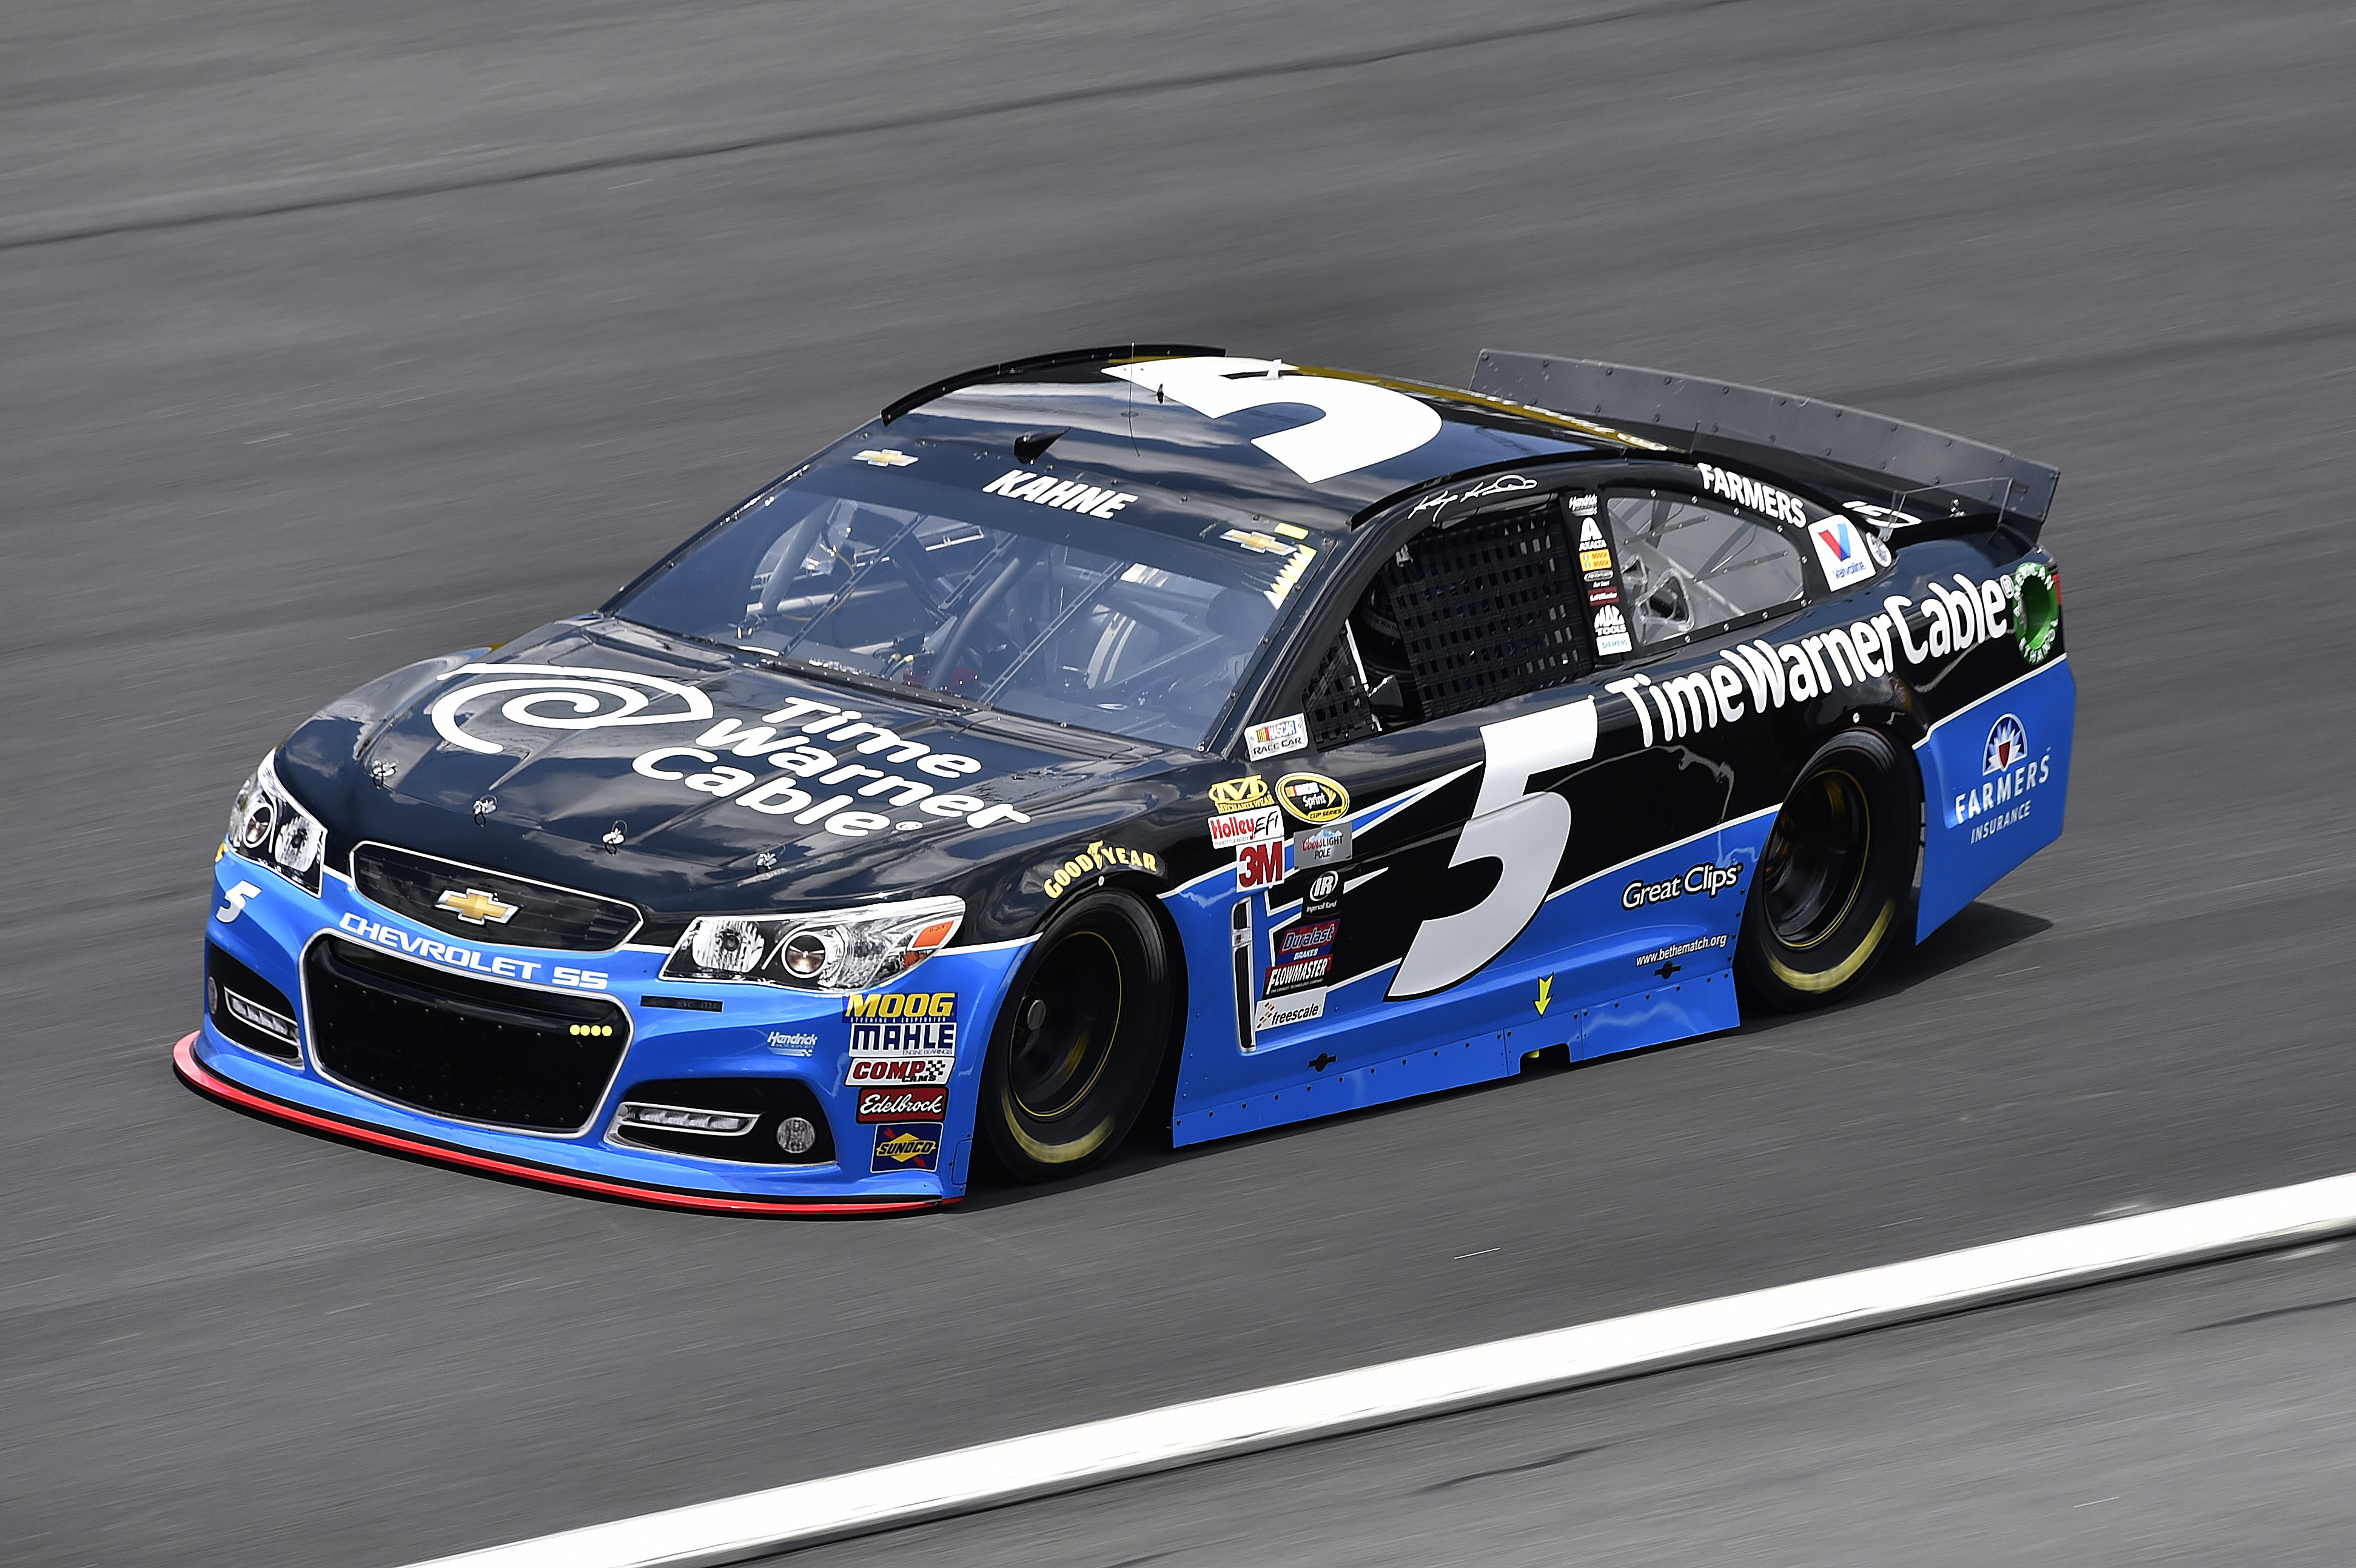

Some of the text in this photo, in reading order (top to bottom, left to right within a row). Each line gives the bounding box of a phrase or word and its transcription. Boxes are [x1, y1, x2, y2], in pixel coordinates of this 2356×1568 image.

[1101, 356, 1443, 484] 5
[982, 469, 1138, 519] KAHNE
[1697, 462, 1807, 528] FARMERS
[1831, 561, 1866, 580] Valvoline
[1595, 624, 1626, 637] TOOLS
[761, 697, 982, 779] Time
[1268, 720, 1297, 741] NASCAR
[1254, 737, 1301, 754] RACE CAR
[695, 718, 1031, 829] Warner
[632, 746, 891, 836] Cable
[1303, 792, 1327, 809] Sprint
[1955, 754, 2050, 824] FARMERS
[1210, 811, 1278, 840] Holley EFI
[1322, 809, 1341, 817] SERIES
[1970, 800, 2032, 845] INSURANCE
[1302, 835, 1343, 851] Coors LIGHT
[1314, 848, 1331, 859] POLE
[1386, 694, 1599, 999] 5
[1044, 840, 1156, 899] GOODYEAR
[1239, 840, 1283, 888] 3M
[1314, 876, 1334, 896] IR
[1623, 865, 1737, 908] Great Clips
[215, 880, 261, 923] 5
[339, 912, 609, 990] CHEVROLET SS
[1282, 923, 1335, 951] Duralast
[1636, 934, 1727, 967] www.bethematch.org
[1294, 948, 1319, 960] BRAKES
[1266, 957, 1328, 995] FLOWMASTER
[845, 993, 956, 1017] MOOG
[1271, 1003, 1319, 1025] freescale
[767, 1031, 818, 1047] Hendrick
[852, 1024, 955, 1050] MAHLE
[853, 1060, 926, 1080] COMP
[860, 1093, 943, 1114] Edelbrock
[878, 1141, 934, 1155] SUNOCO
